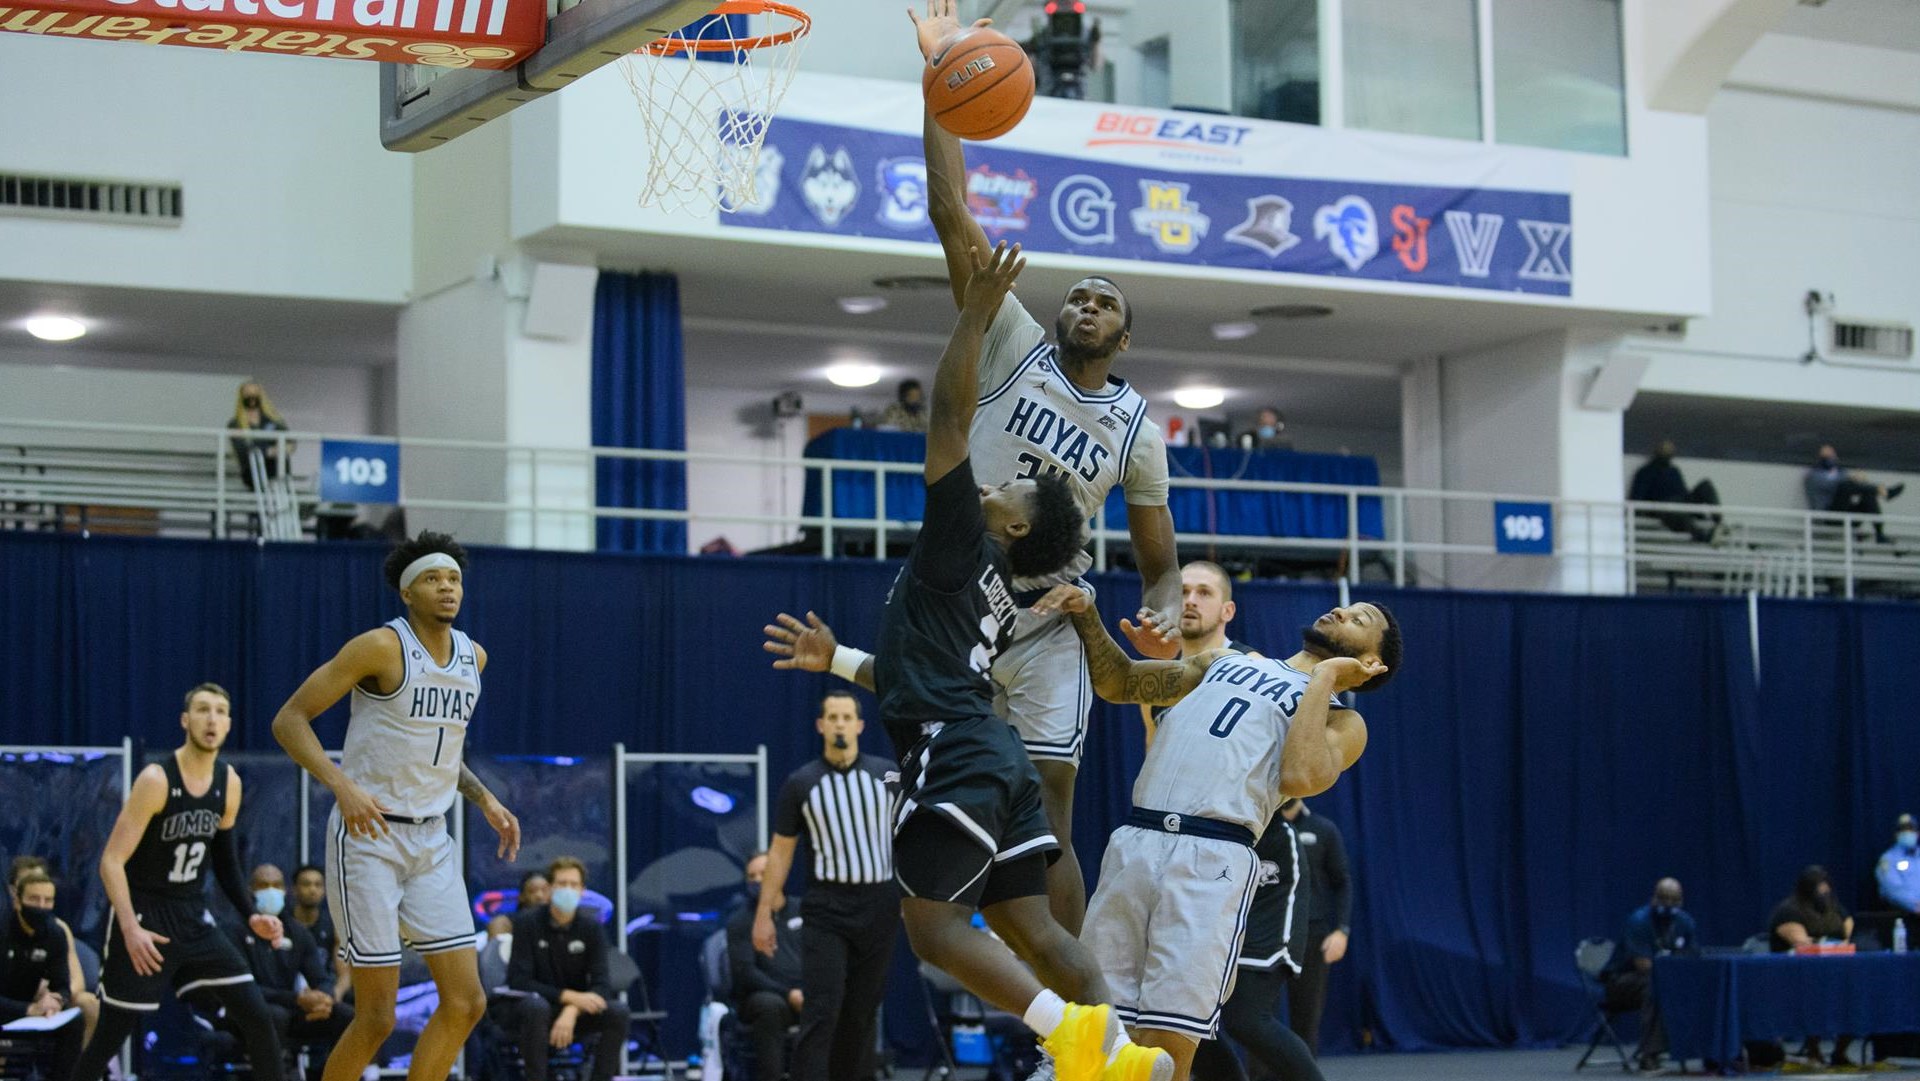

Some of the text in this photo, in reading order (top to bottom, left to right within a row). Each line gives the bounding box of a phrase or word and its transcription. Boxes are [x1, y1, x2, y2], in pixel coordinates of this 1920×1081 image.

[1156, 119, 1252, 146] EAST
[1050, 174, 1115, 245] G
[1444, 210, 1504, 278] V
[1004, 396, 1109, 482] HOYAS
[335, 456, 388, 487] 103
[1503, 514, 1545, 541] 105
[410, 687, 474, 721] HOYAS
[1207, 663, 1304, 718] HOYAS
[1209, 696, 1251, 739] 0
[433, 726, 445, 767] 1
[168, 841, 206, 883] 12
